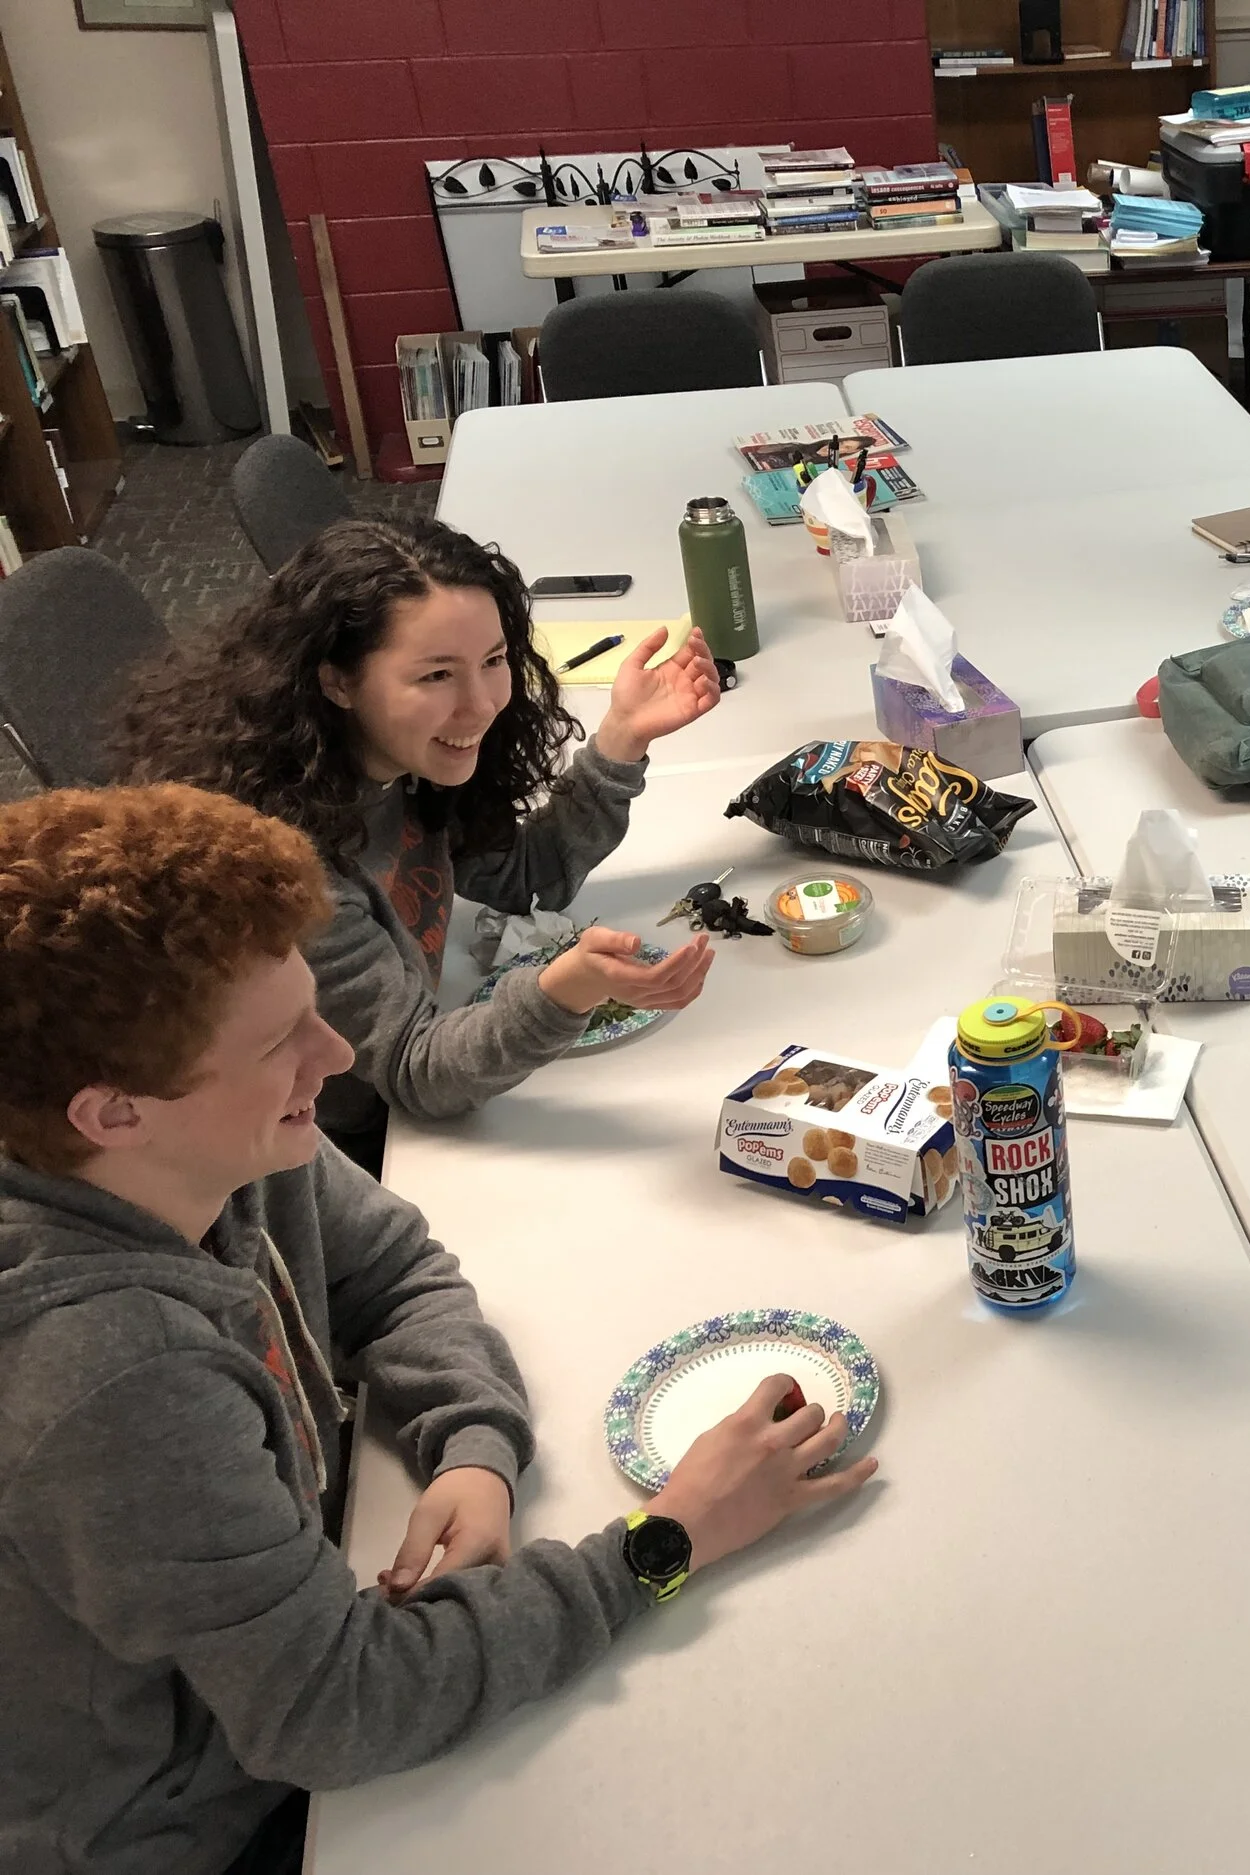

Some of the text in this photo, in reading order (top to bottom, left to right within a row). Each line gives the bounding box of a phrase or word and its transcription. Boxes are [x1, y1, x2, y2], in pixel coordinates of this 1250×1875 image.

[819, 750, 843, 777] NAKED
[855, 766, 871, 784] SIZE
[862, 764, 881, 787] PARTY
[886, 1078, 931, 1135] Entenmann's
[985, 1099, 1034, 1116] Speedway
[994, 1109, 1027, 1125] Cycles
[725, 1118, 794, 1137] Entenmann's
[746, 1154, 772, 1167] GLAZED
[991, 1132, 1052, 1172] ROCK
[994, 1166, 1053, 1206] SHOX
